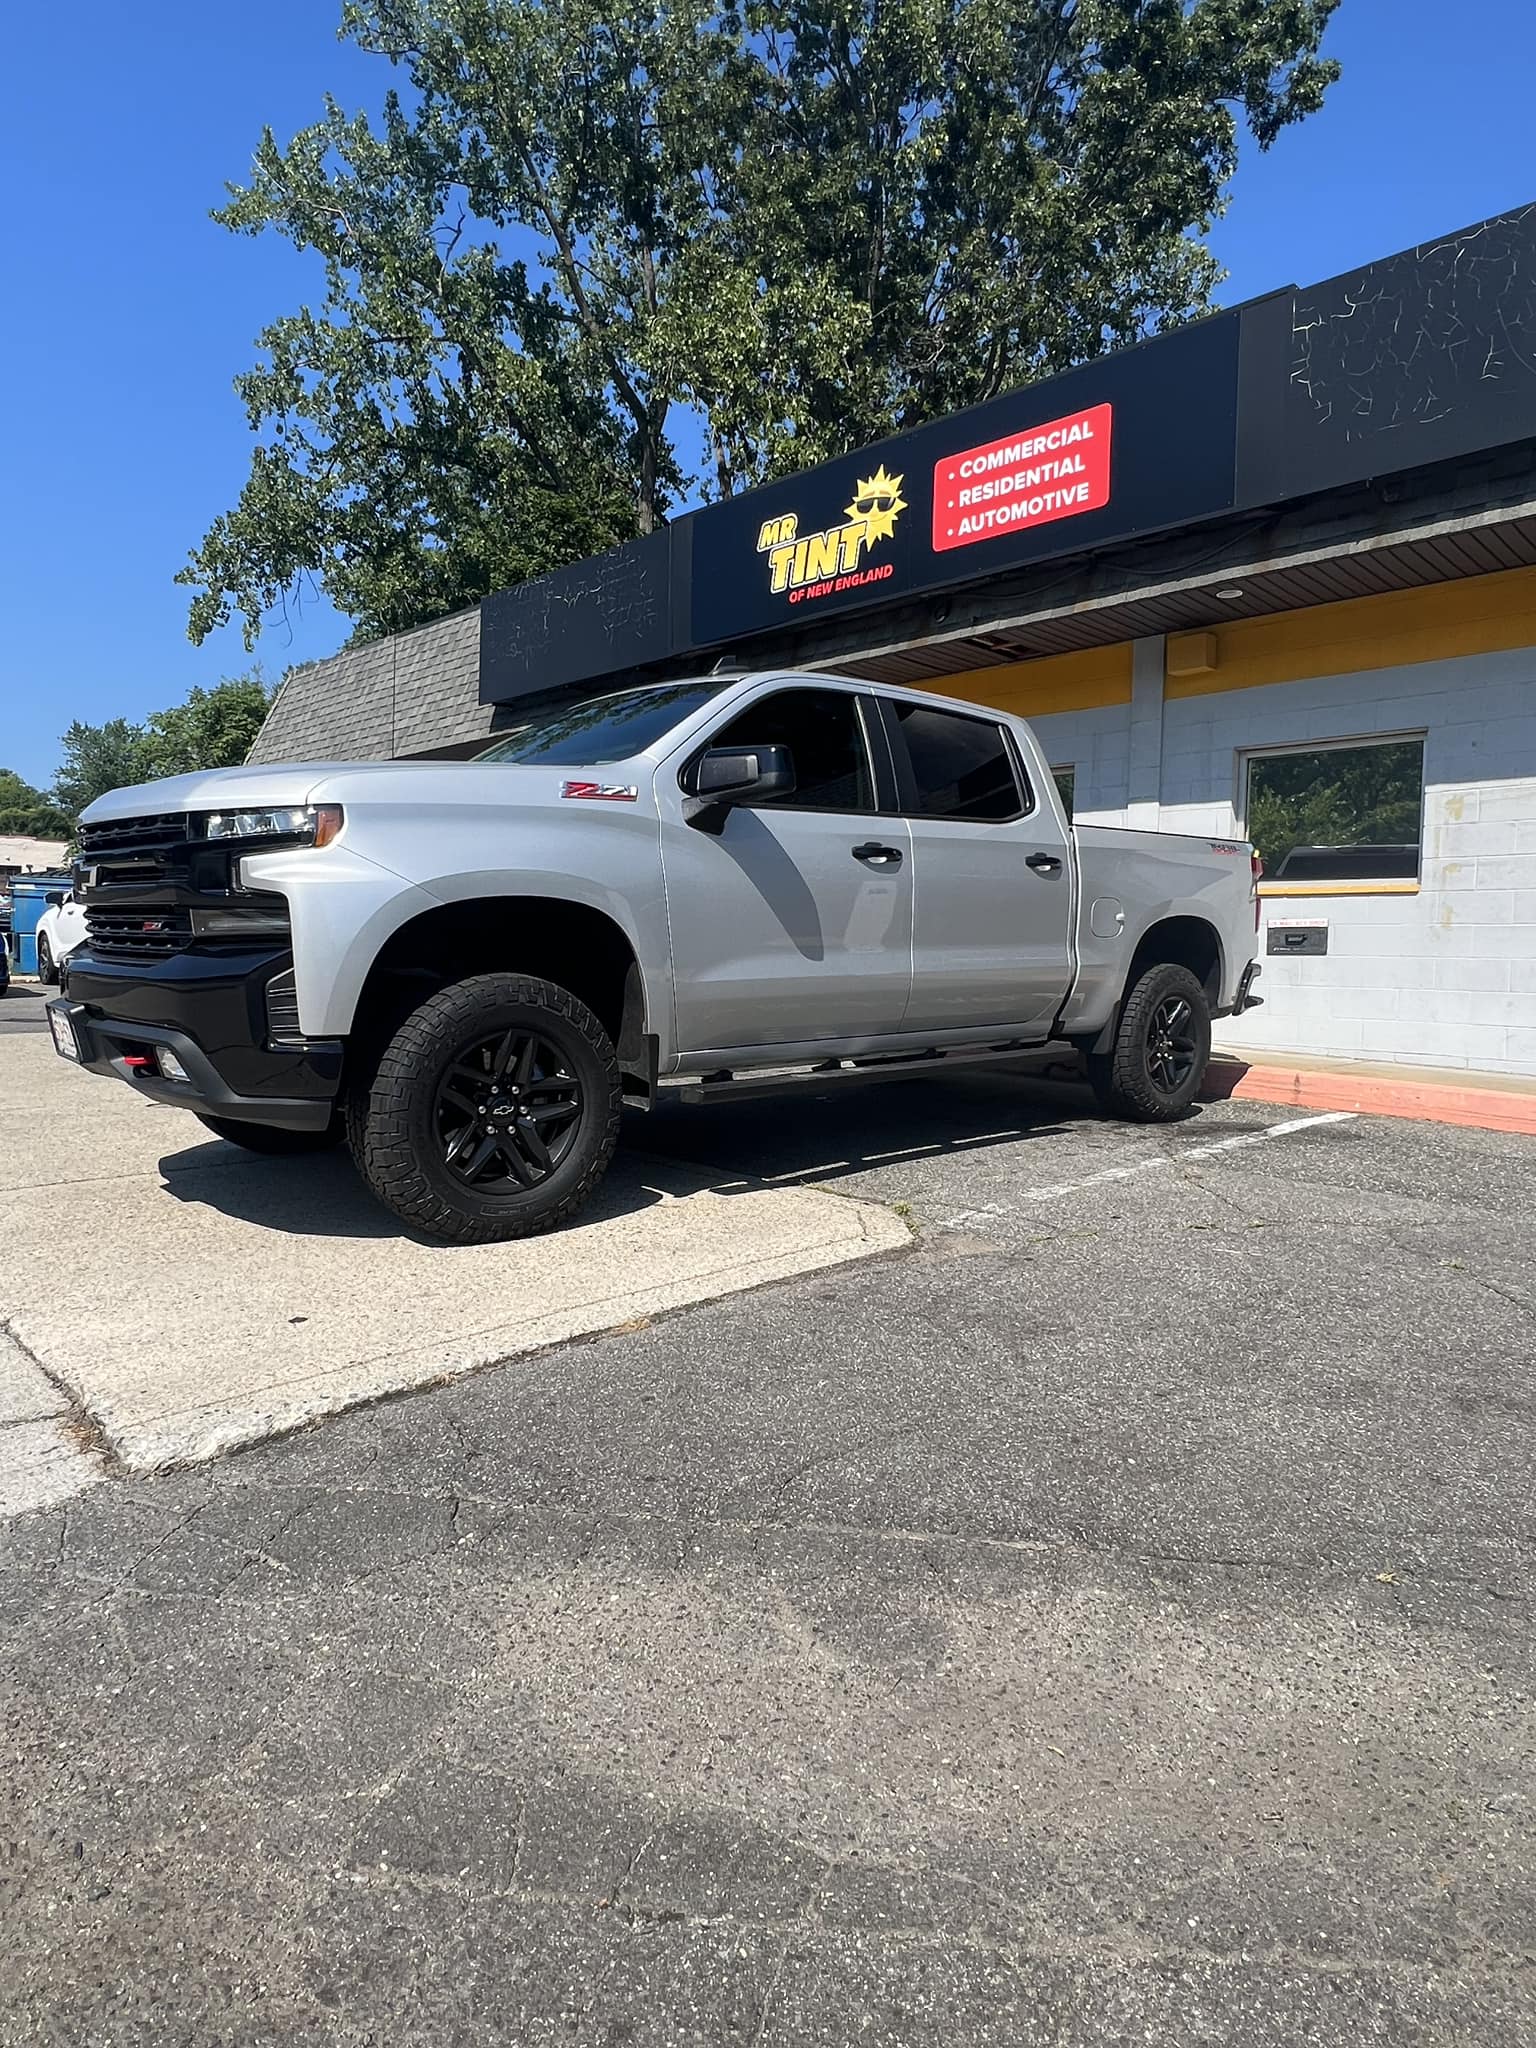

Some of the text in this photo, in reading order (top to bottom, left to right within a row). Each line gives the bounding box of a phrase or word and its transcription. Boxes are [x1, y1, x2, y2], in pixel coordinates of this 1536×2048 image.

[959, 421, 1094, 478] COMMERCIAL
[959, 454, 1086, 507] RESIDENTIAL
[758, 514, 798, 551] MR
[958, 482, 1089, 536] AUTOMOTIVE
[770, 520, 867, 592] TINT
[788, 564, 893, 603] OF NEW ENGLAND
[560, 781, 638, 802] Z71
